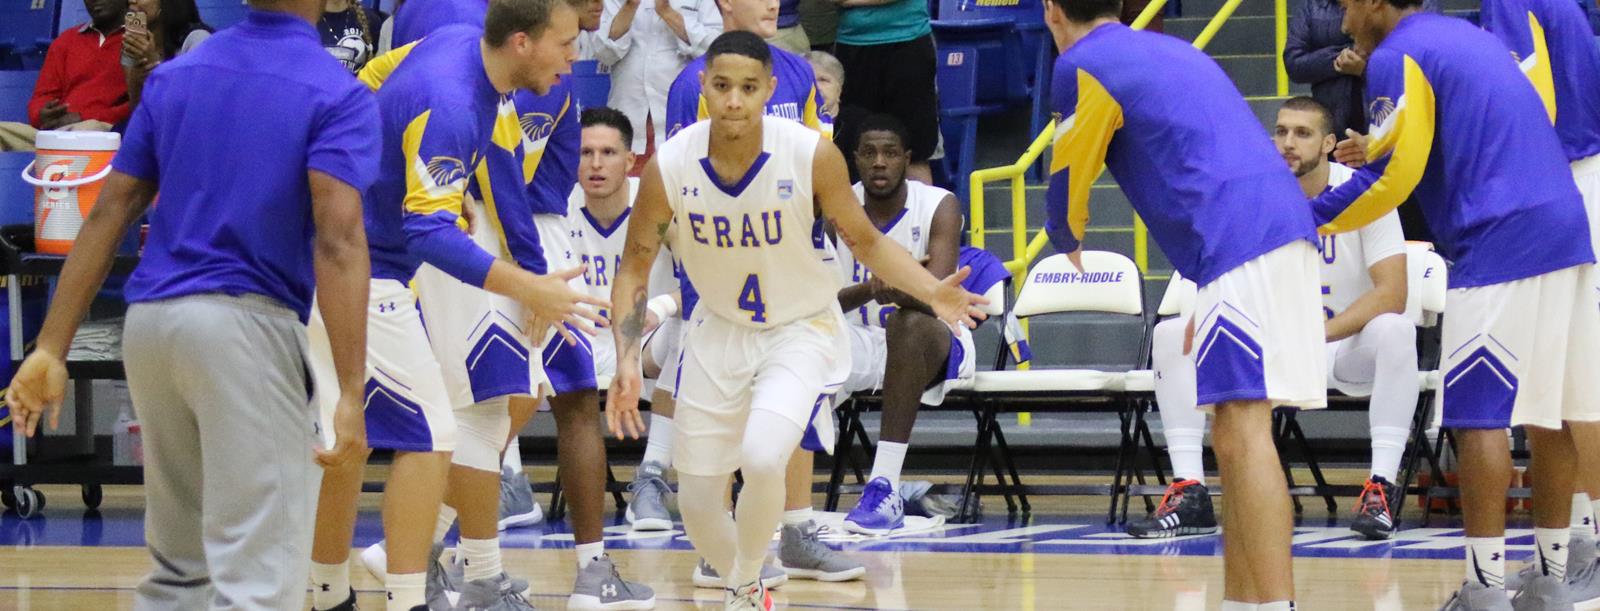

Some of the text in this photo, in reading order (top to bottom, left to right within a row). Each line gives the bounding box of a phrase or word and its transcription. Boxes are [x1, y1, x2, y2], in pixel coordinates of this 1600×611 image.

[689, 210, 783, 248] ERAU
[1034, 271, 1124, 283] EMBRY-RIDDLE
[738, 273, 767, 323] 4
